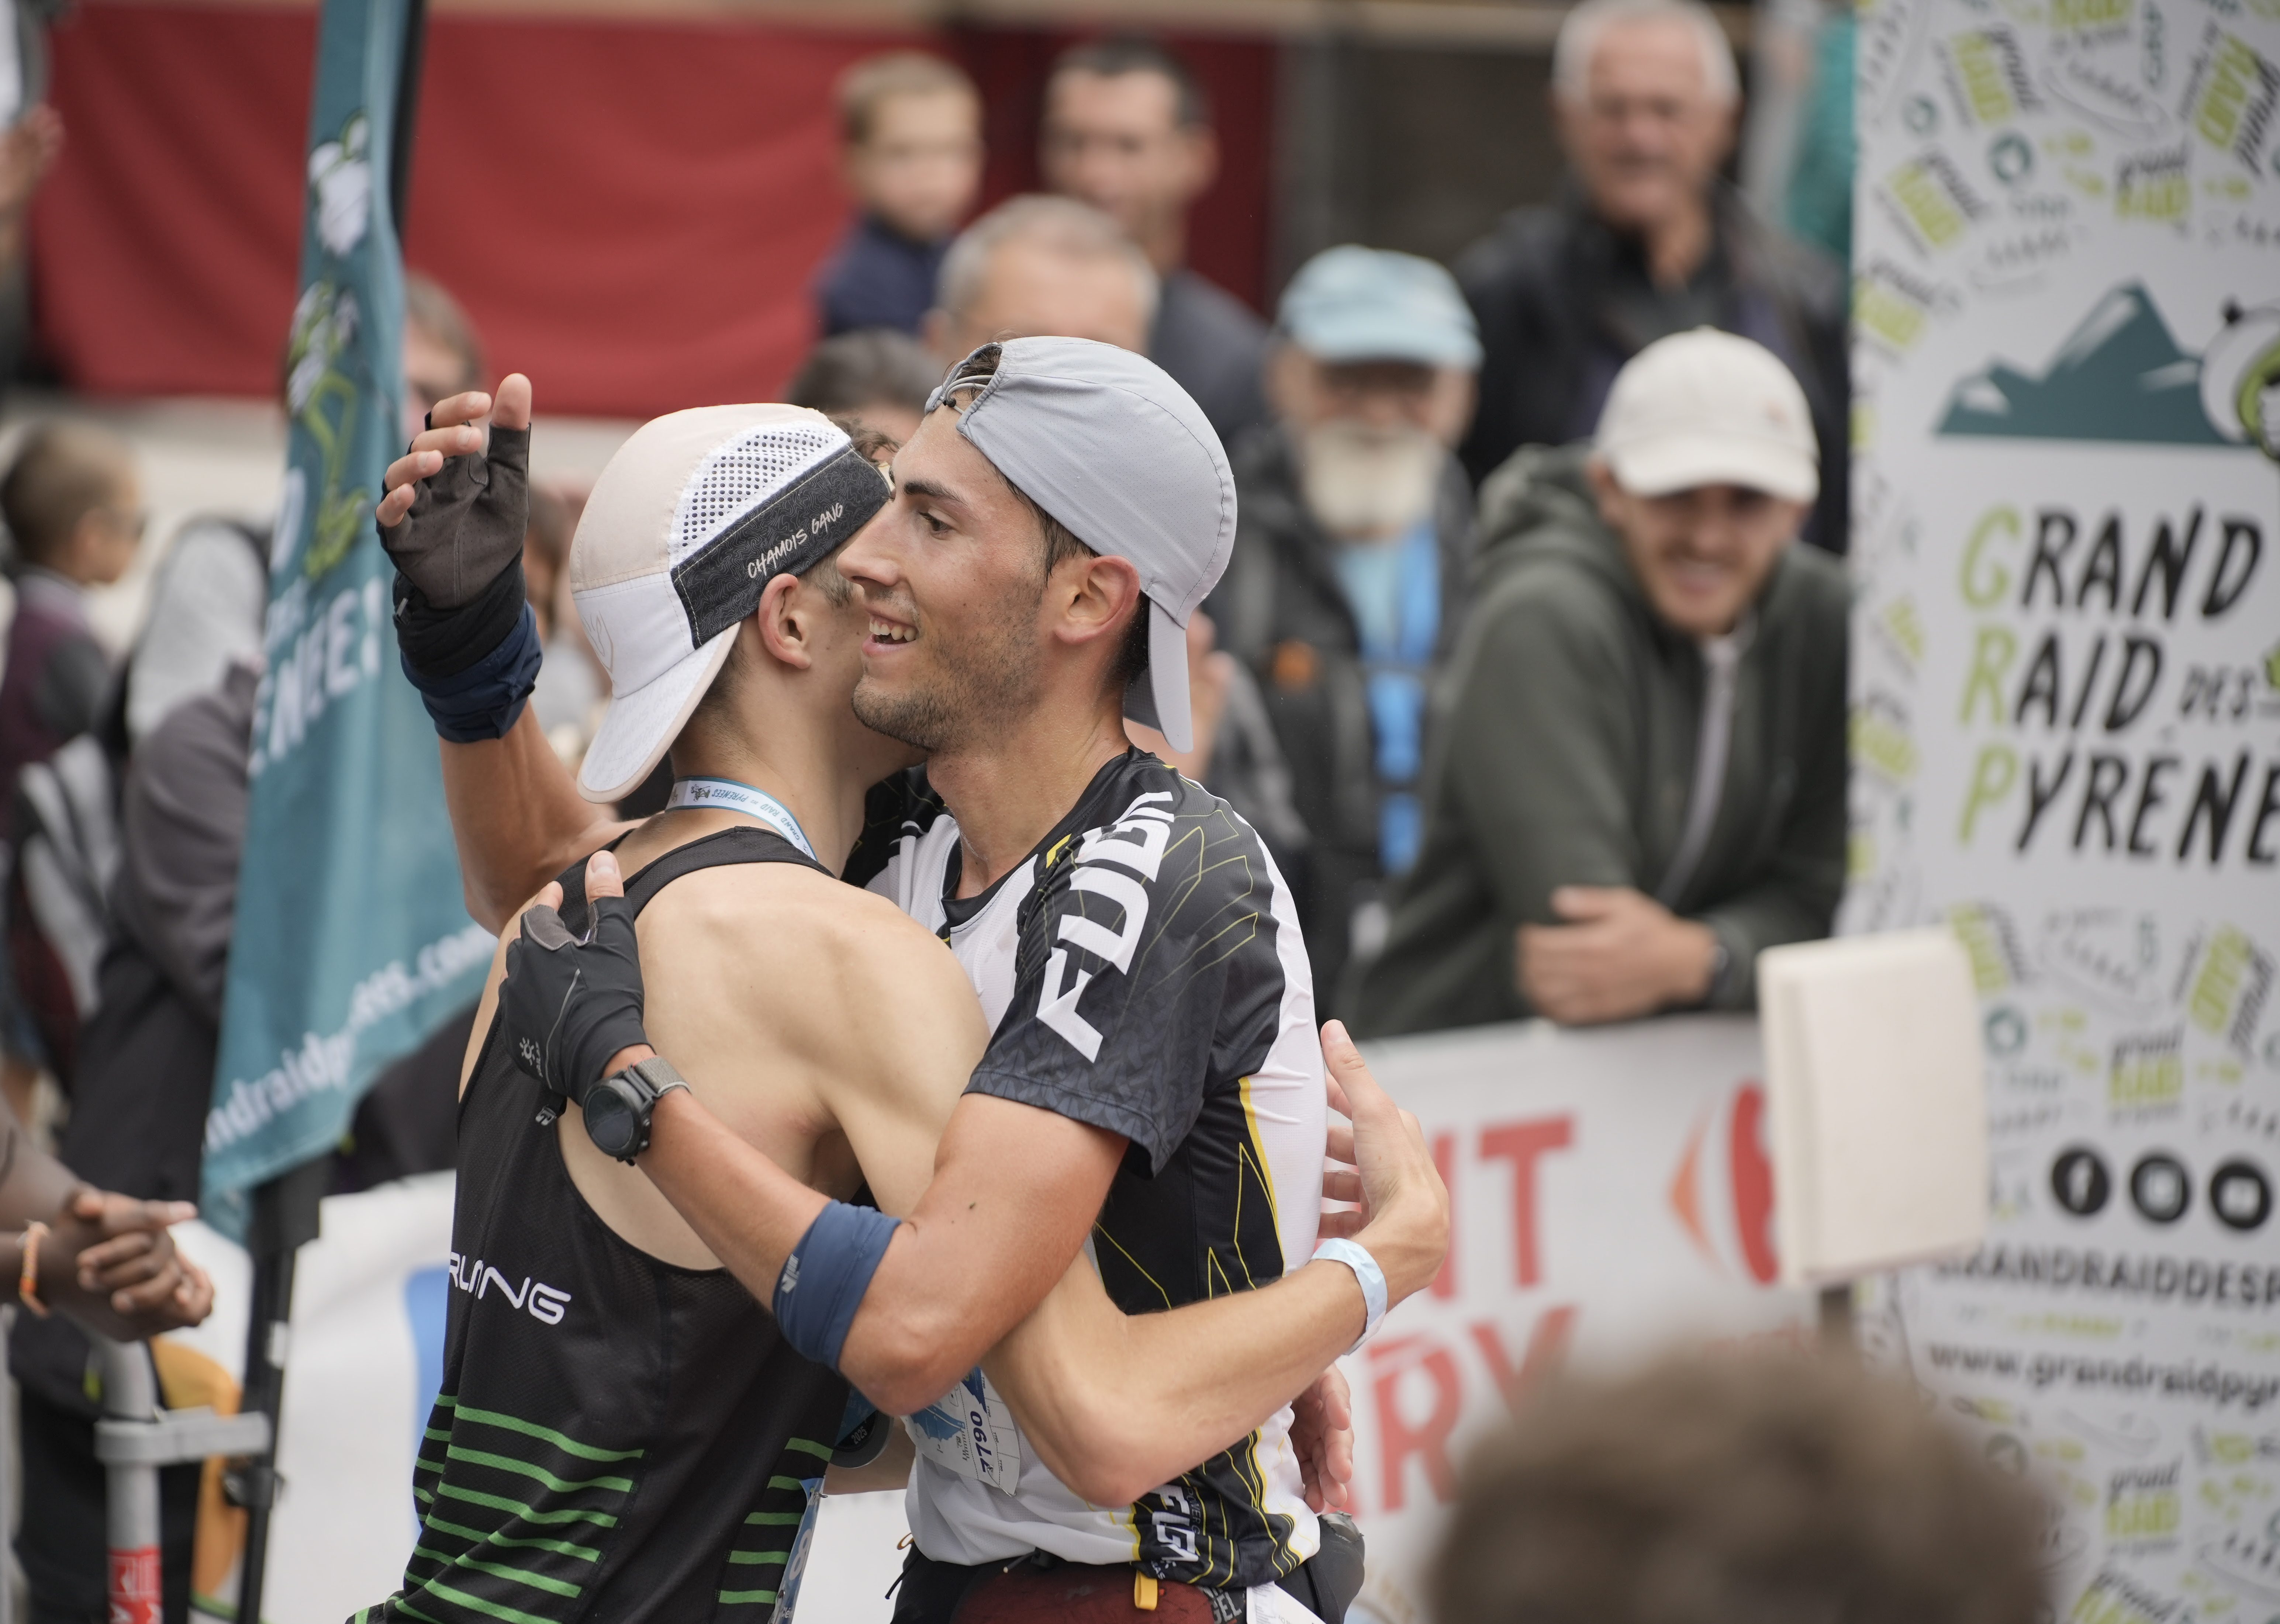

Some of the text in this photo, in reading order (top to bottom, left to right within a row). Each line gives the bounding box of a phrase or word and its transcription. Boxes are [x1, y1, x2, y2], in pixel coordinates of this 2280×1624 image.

[748, 503, 843, 578] CHAMOIS GANG
[1959, 502, 2262, 617] GRAND
[1961, 627, 2160, 730] RAID
[760, 804, 781, 817] RAID
[781, 818, 800, 840] GRAND
[851, 1426, 867, 1445] 2025
[970, 1411, 992, 1473] 7790
[1187, 1487, 1201, 1524] POWER
